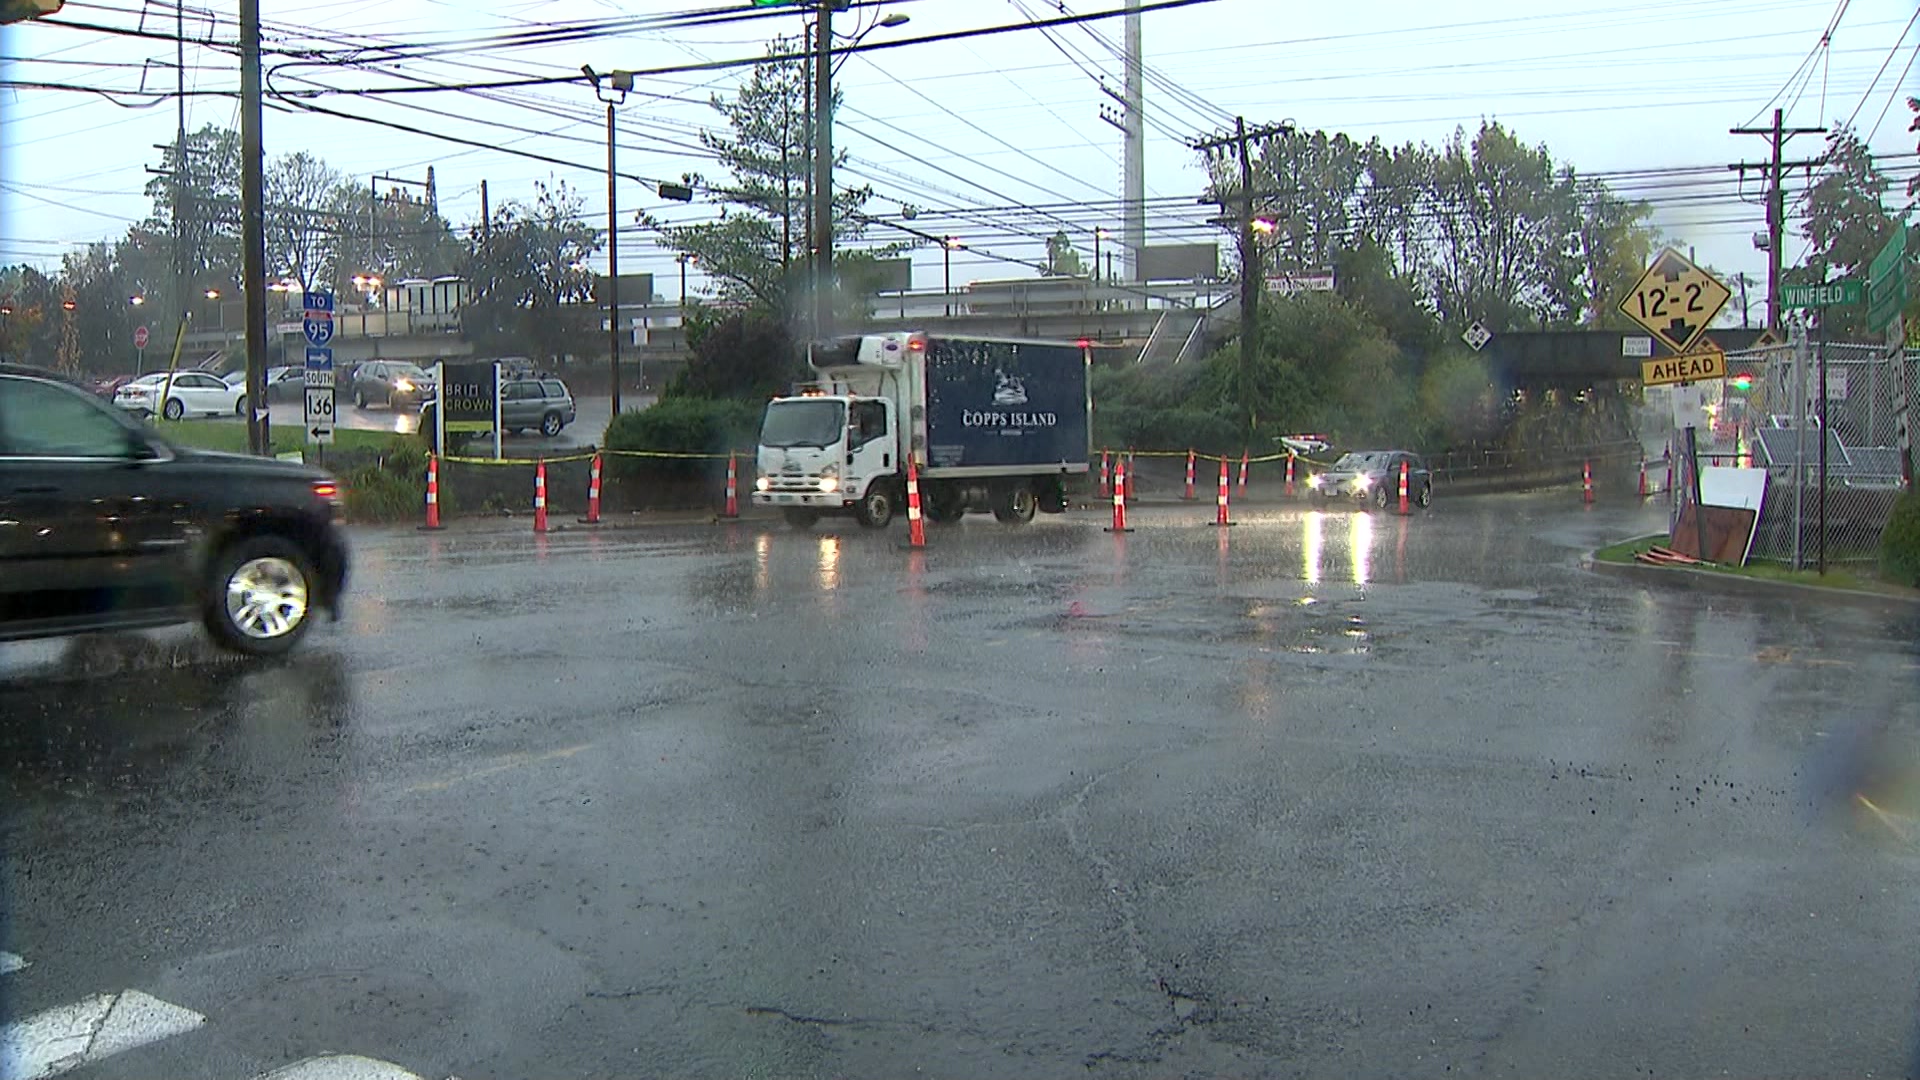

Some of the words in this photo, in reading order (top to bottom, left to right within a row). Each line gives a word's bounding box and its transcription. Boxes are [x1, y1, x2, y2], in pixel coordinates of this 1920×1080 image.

[311, 296, 325, 308] TO
[1785, 286, 1843, 306] WINFIELD
[308, 322, 329, 341] 95
[1652, 357, 1714, 380] AHEAD
[306, 372, 333, 384] SOUTH
[445, 383, 479, 397] BRIM
[308, 395, 332, 416] 136
[445, 398, 493, 412] CROWN
[962, 409, 1007, 426] COPPS
[1010, 412, 1057, 427] ISLAND
